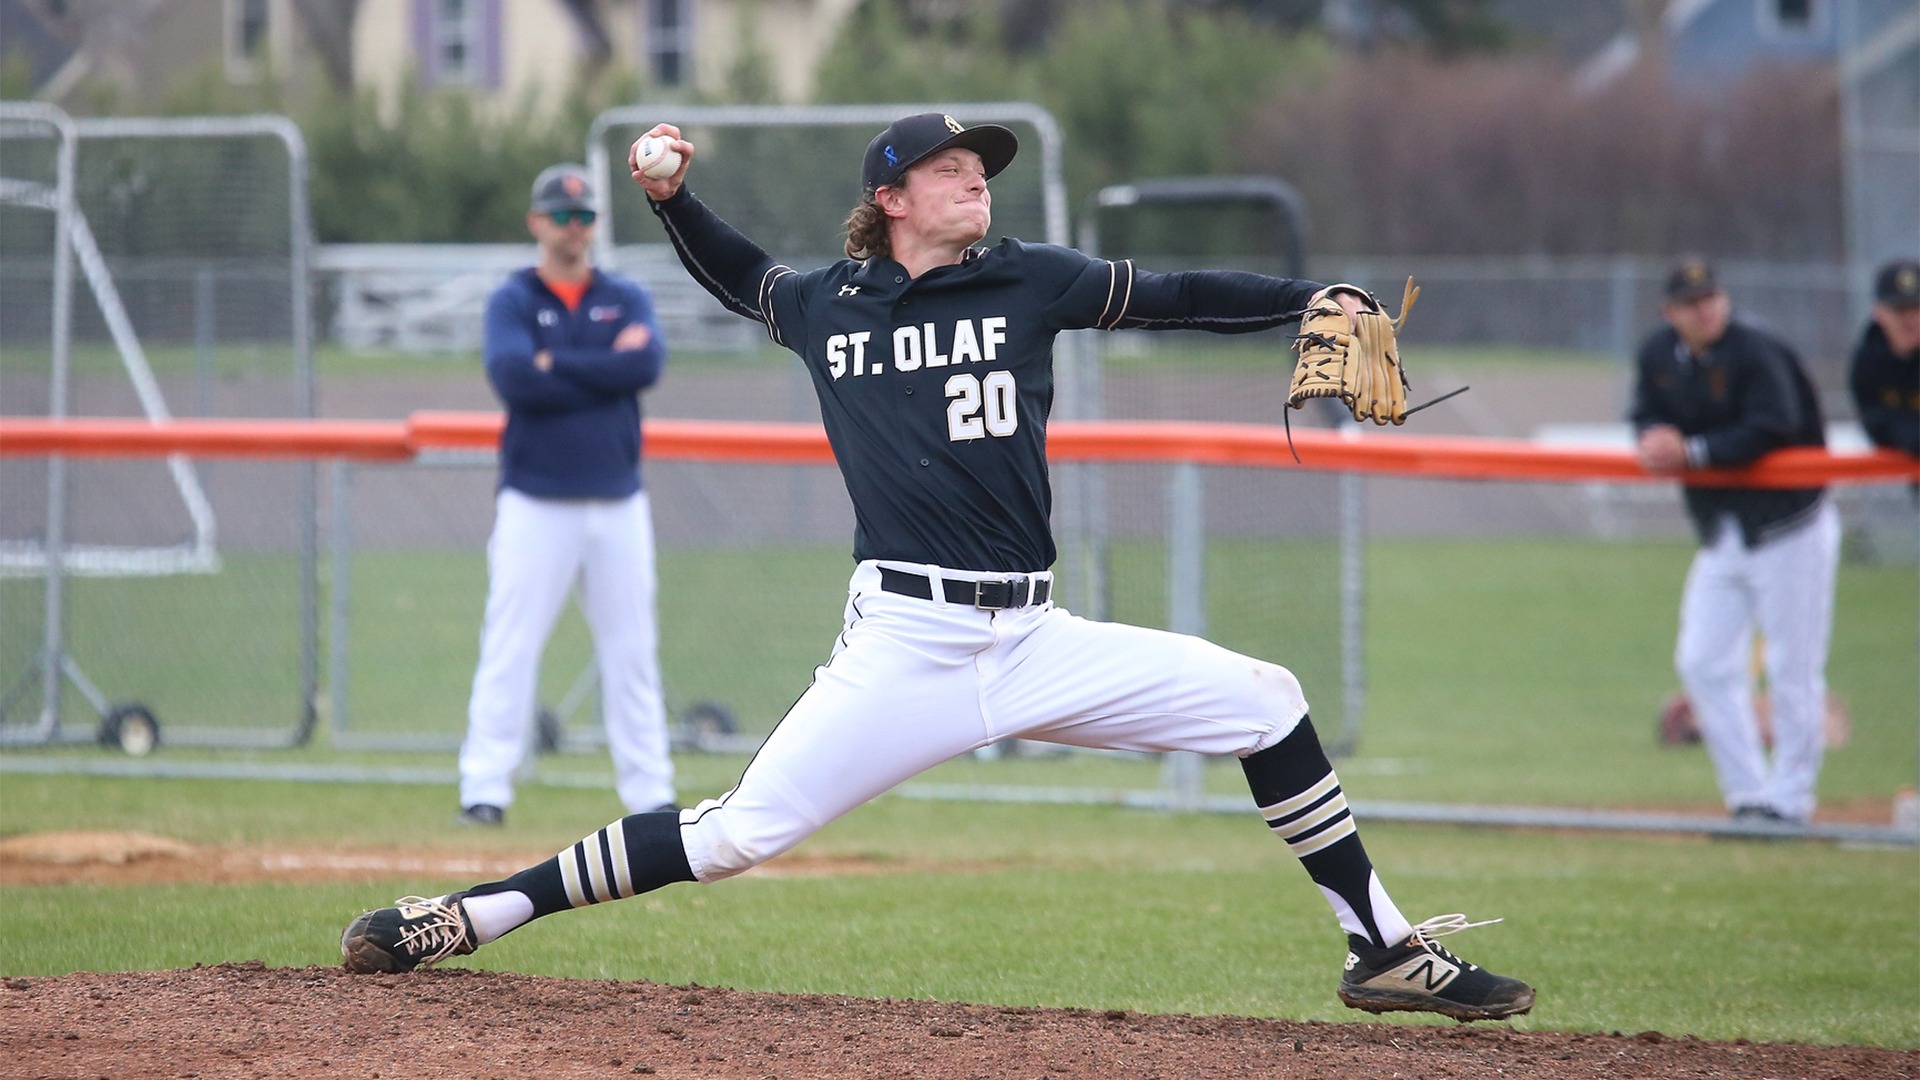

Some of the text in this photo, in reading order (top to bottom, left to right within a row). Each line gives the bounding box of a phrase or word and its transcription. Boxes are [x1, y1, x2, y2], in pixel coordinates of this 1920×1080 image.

[826, 316, 1007, 381] ST. OLAF
[944, 370, 1018, 441] 20
[1405, 959, 1454, 991] N
